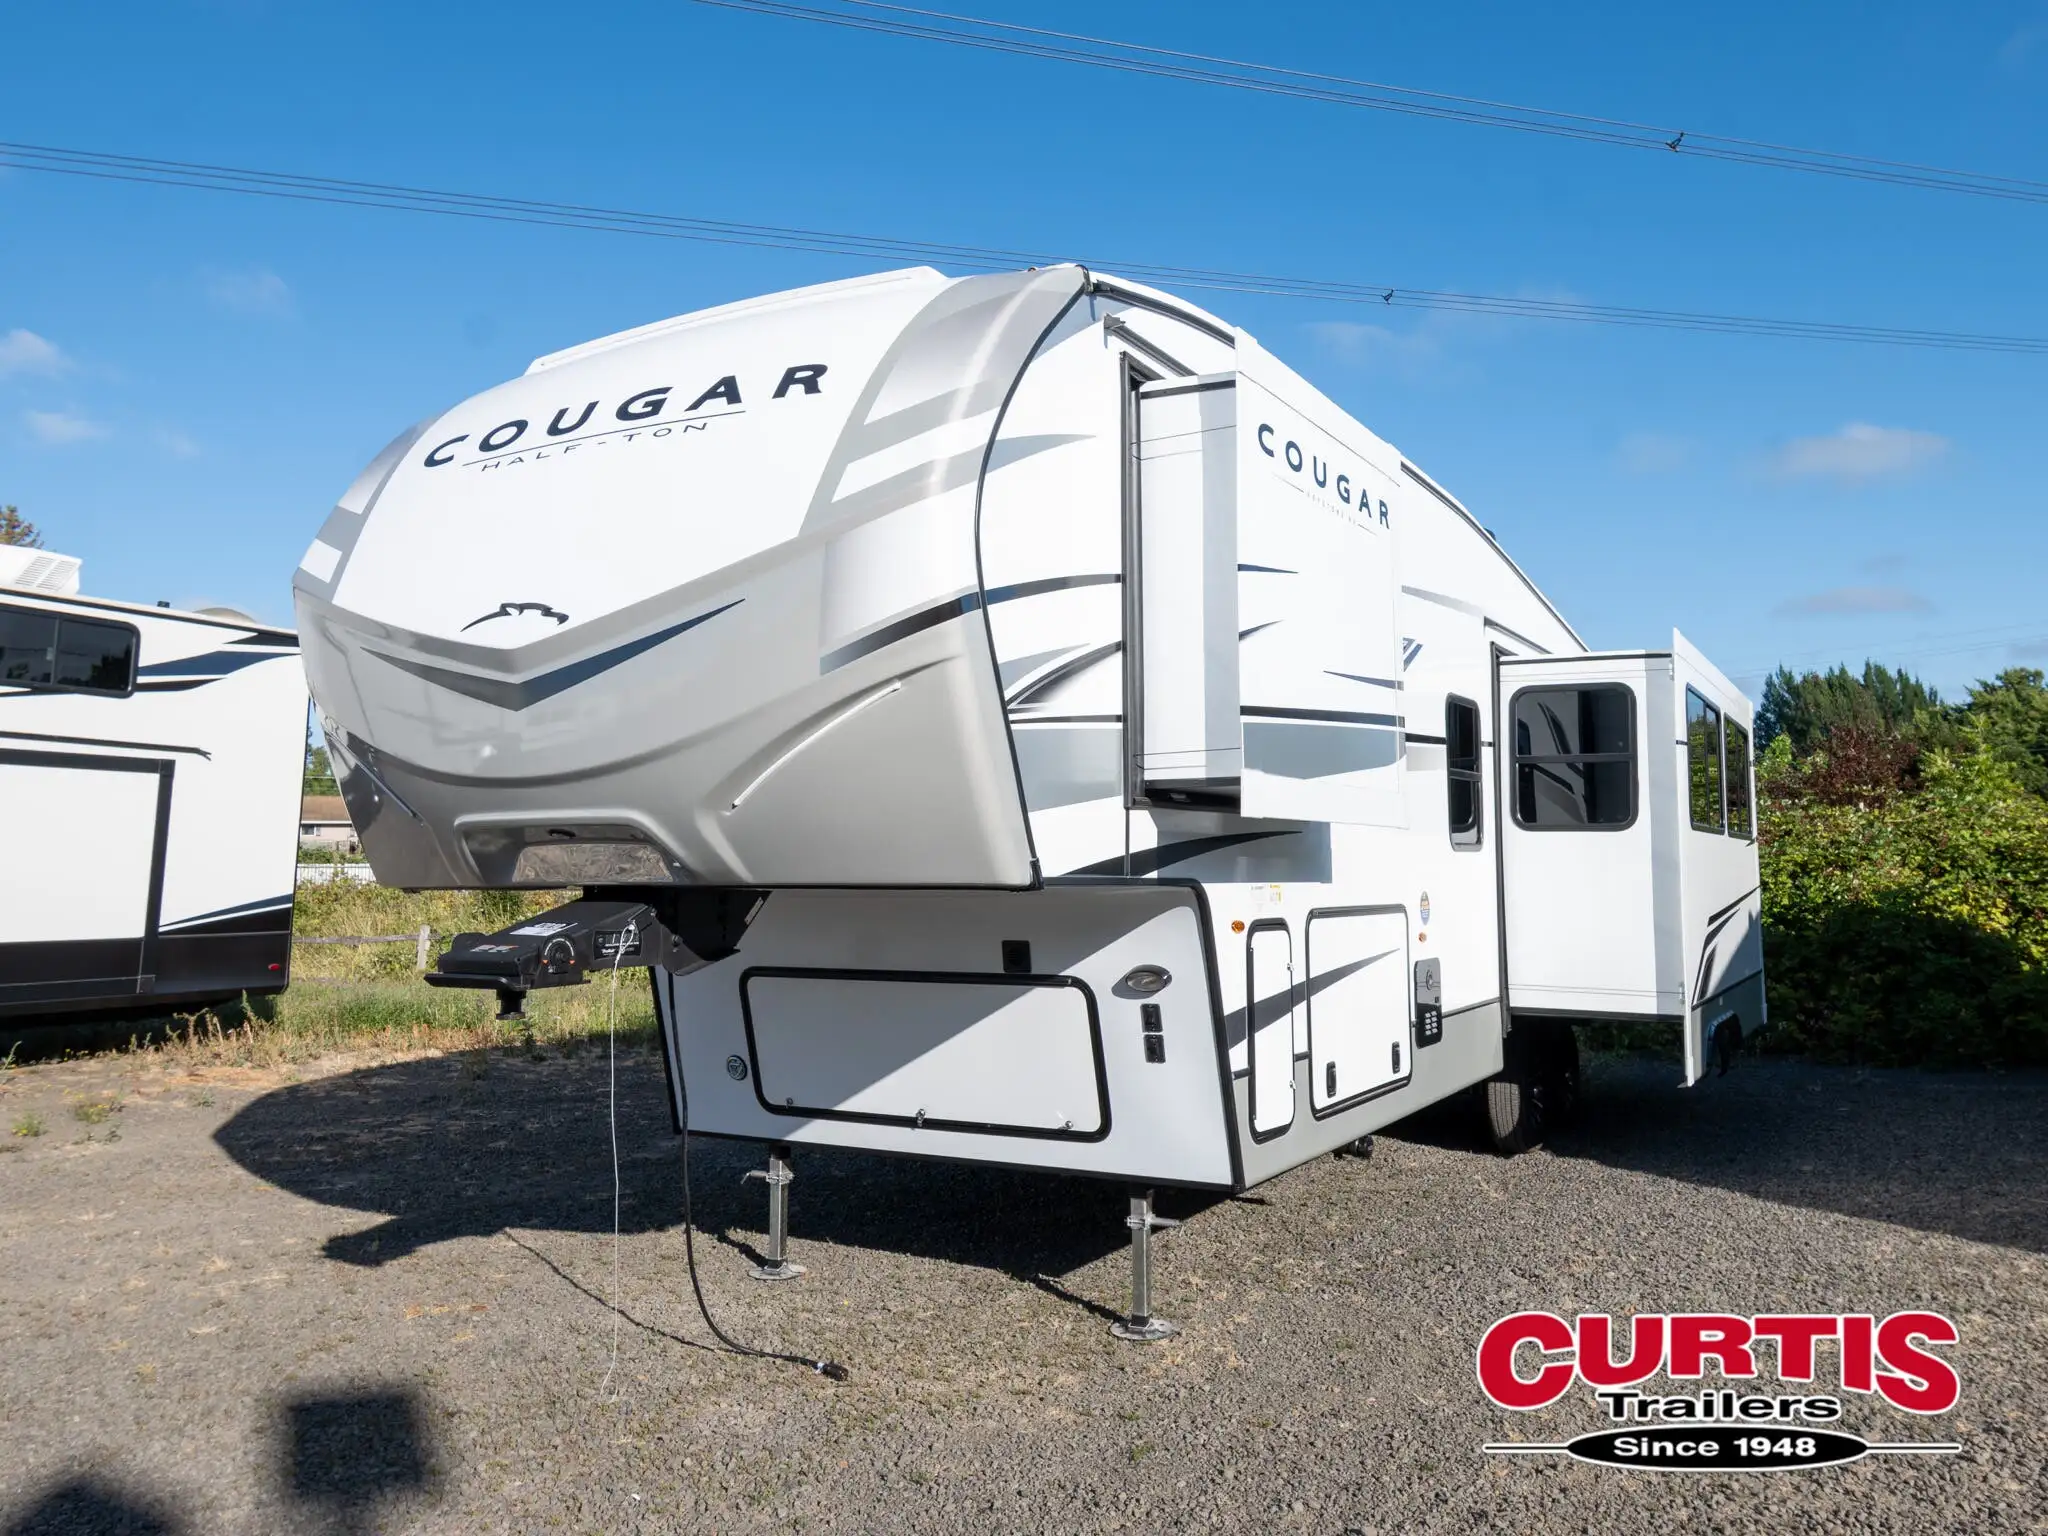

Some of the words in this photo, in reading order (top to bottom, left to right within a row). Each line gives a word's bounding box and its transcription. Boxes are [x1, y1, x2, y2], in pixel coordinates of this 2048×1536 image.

[424, 364, 828, 468] COUGAR
[481, 422, 708, 472] HALF-TON
[1258, 423, 1390, 530] COUGAR
